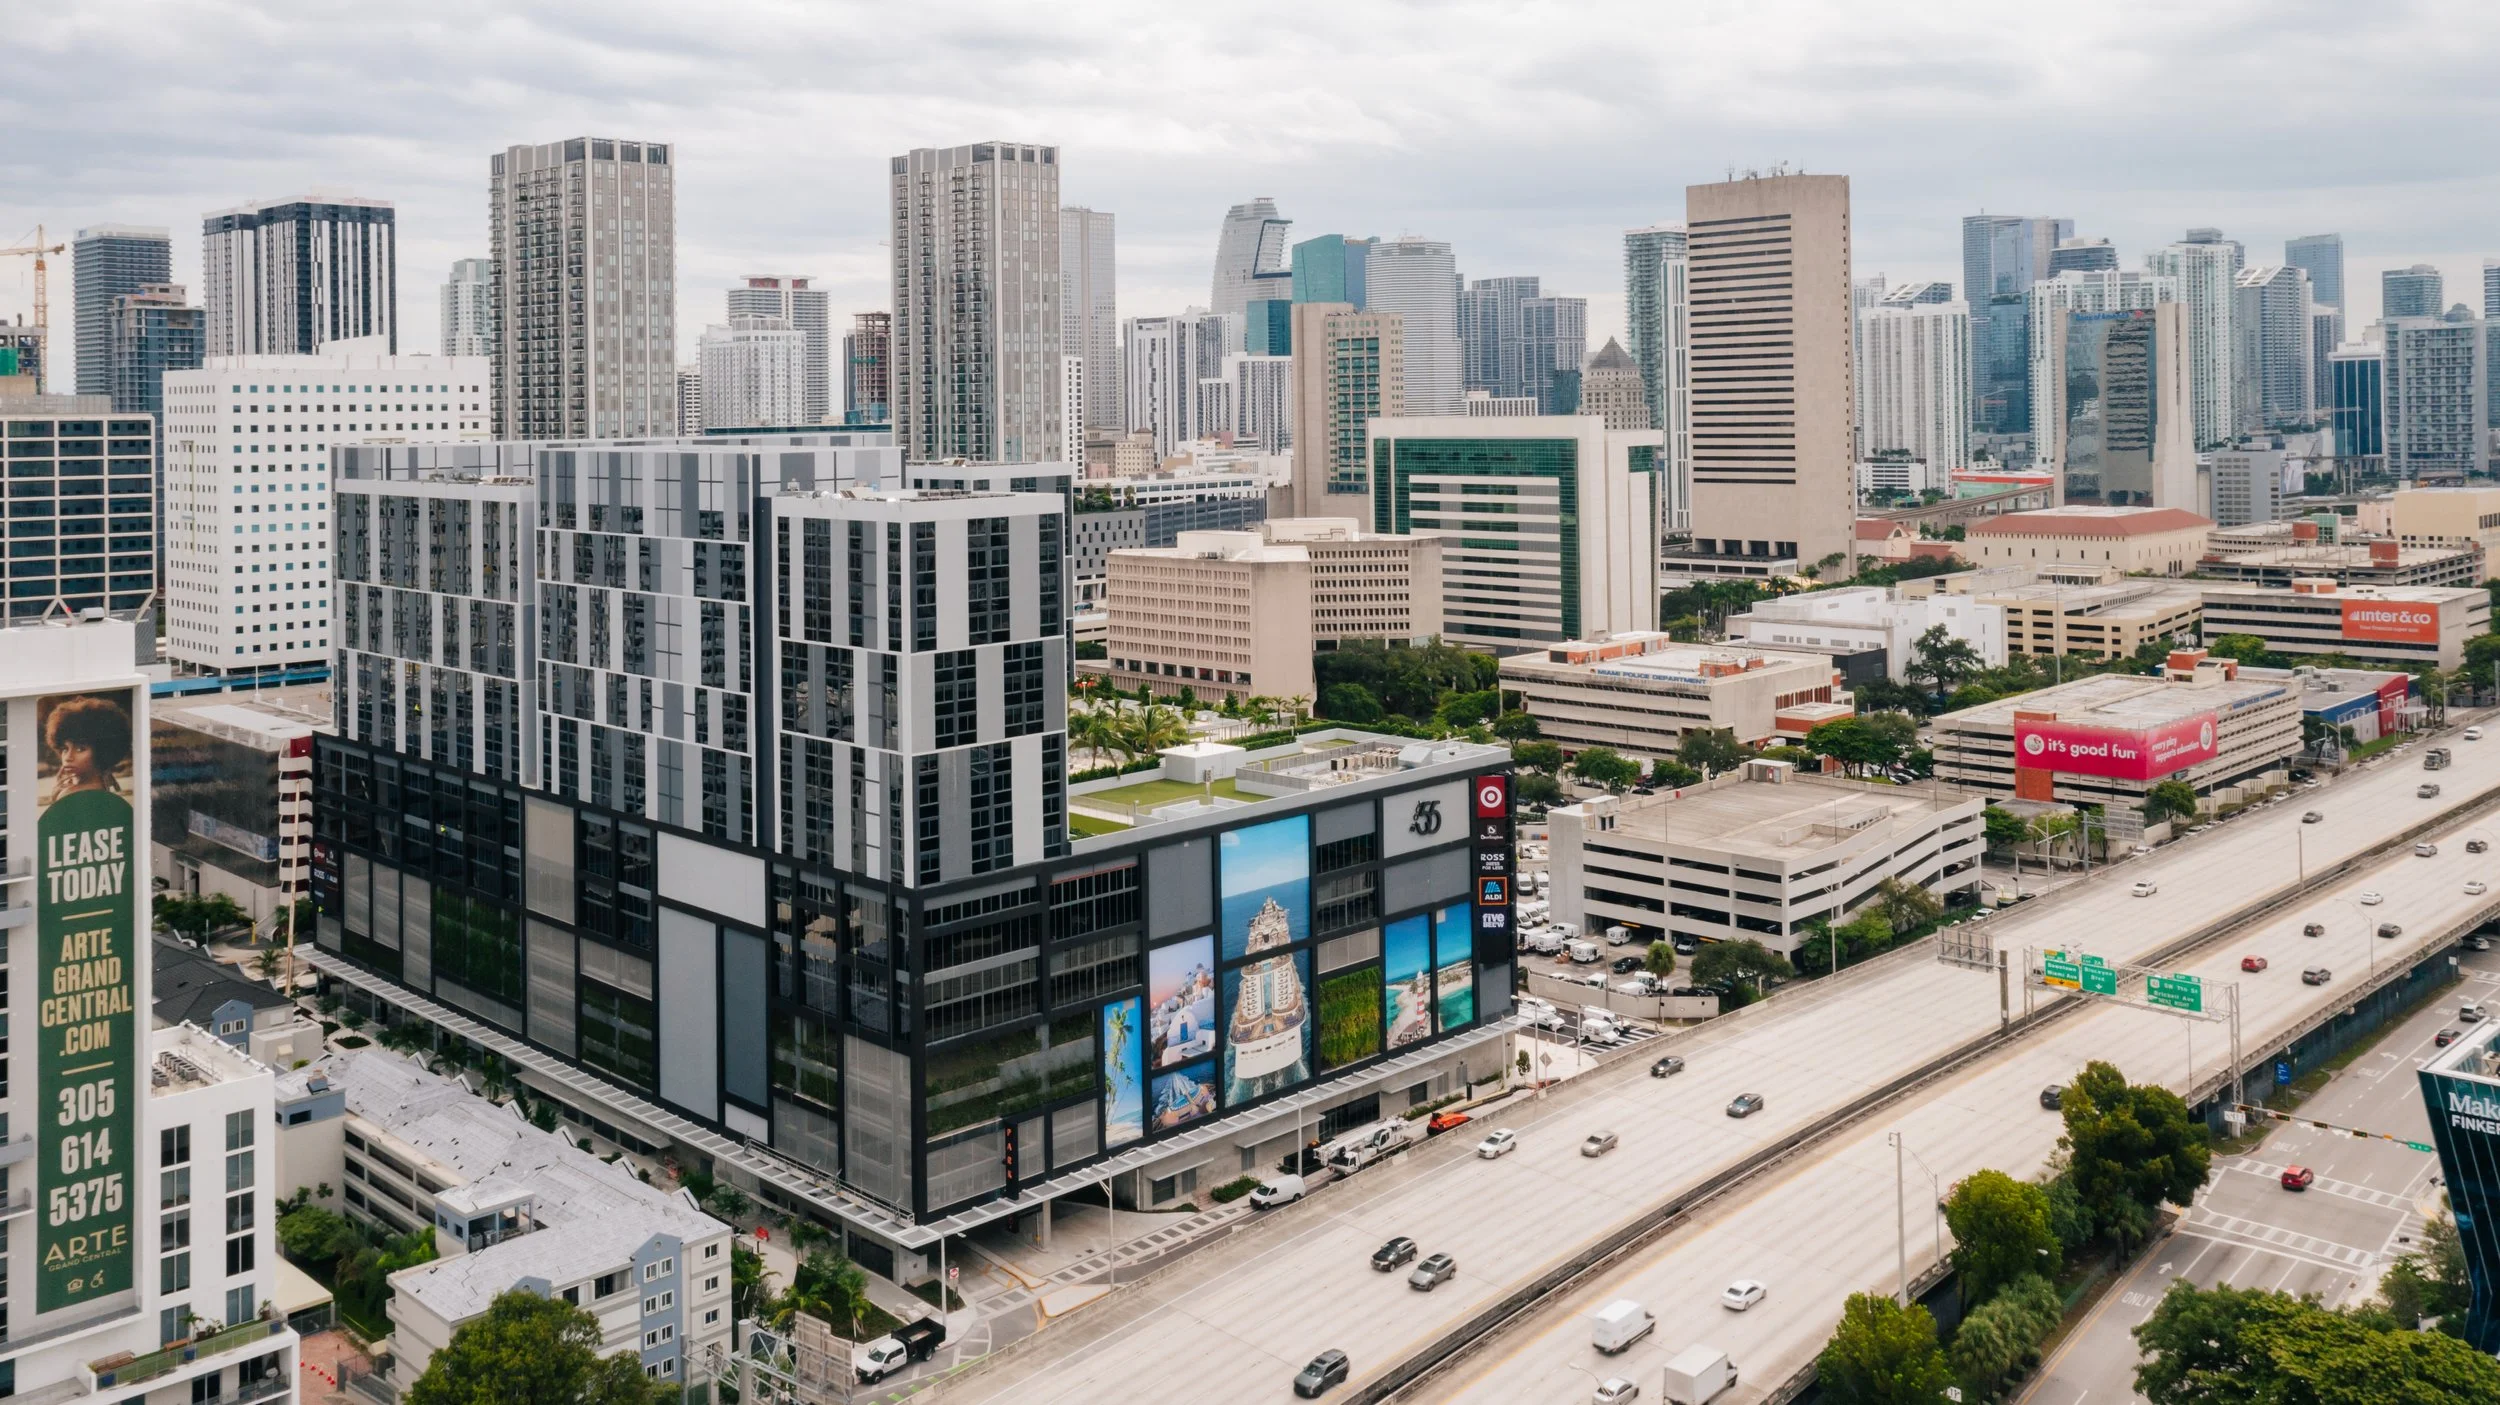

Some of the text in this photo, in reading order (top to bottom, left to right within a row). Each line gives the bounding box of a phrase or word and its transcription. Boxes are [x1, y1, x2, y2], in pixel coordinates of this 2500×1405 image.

[1597, 669, 1706, 684] MIAMI POLICE DEPARTMENT
[2048, 738, 2066, 753] it's
[2070, 743, 2108, 757] good
[48, 826, 124, 868] LEASE
[1480, 853, 1505, 861] ROSS
[47, 861, 125, 904] TODAY
[1482, 913, 1505, 922] five
[60, 927, 113, 963] ARTE
[53, 956, 122, 995] GRAND
[41, 984, 132, 1028] CENTRAL
[59, 1019, 110, 1056] .COM
[58, 1078, 115, 1126] 305
[2448, 1092, 2500, 1120] Mak
[61, 1127, 113, 1175] 614
[49, 1172, 123, 1227] 5375
[43, 1224, 128, 1265] ARTE
[48, 1247, 121, 1272] GRAND CENTRAL
[2121, 1291, 2154, 1308] ONLY
